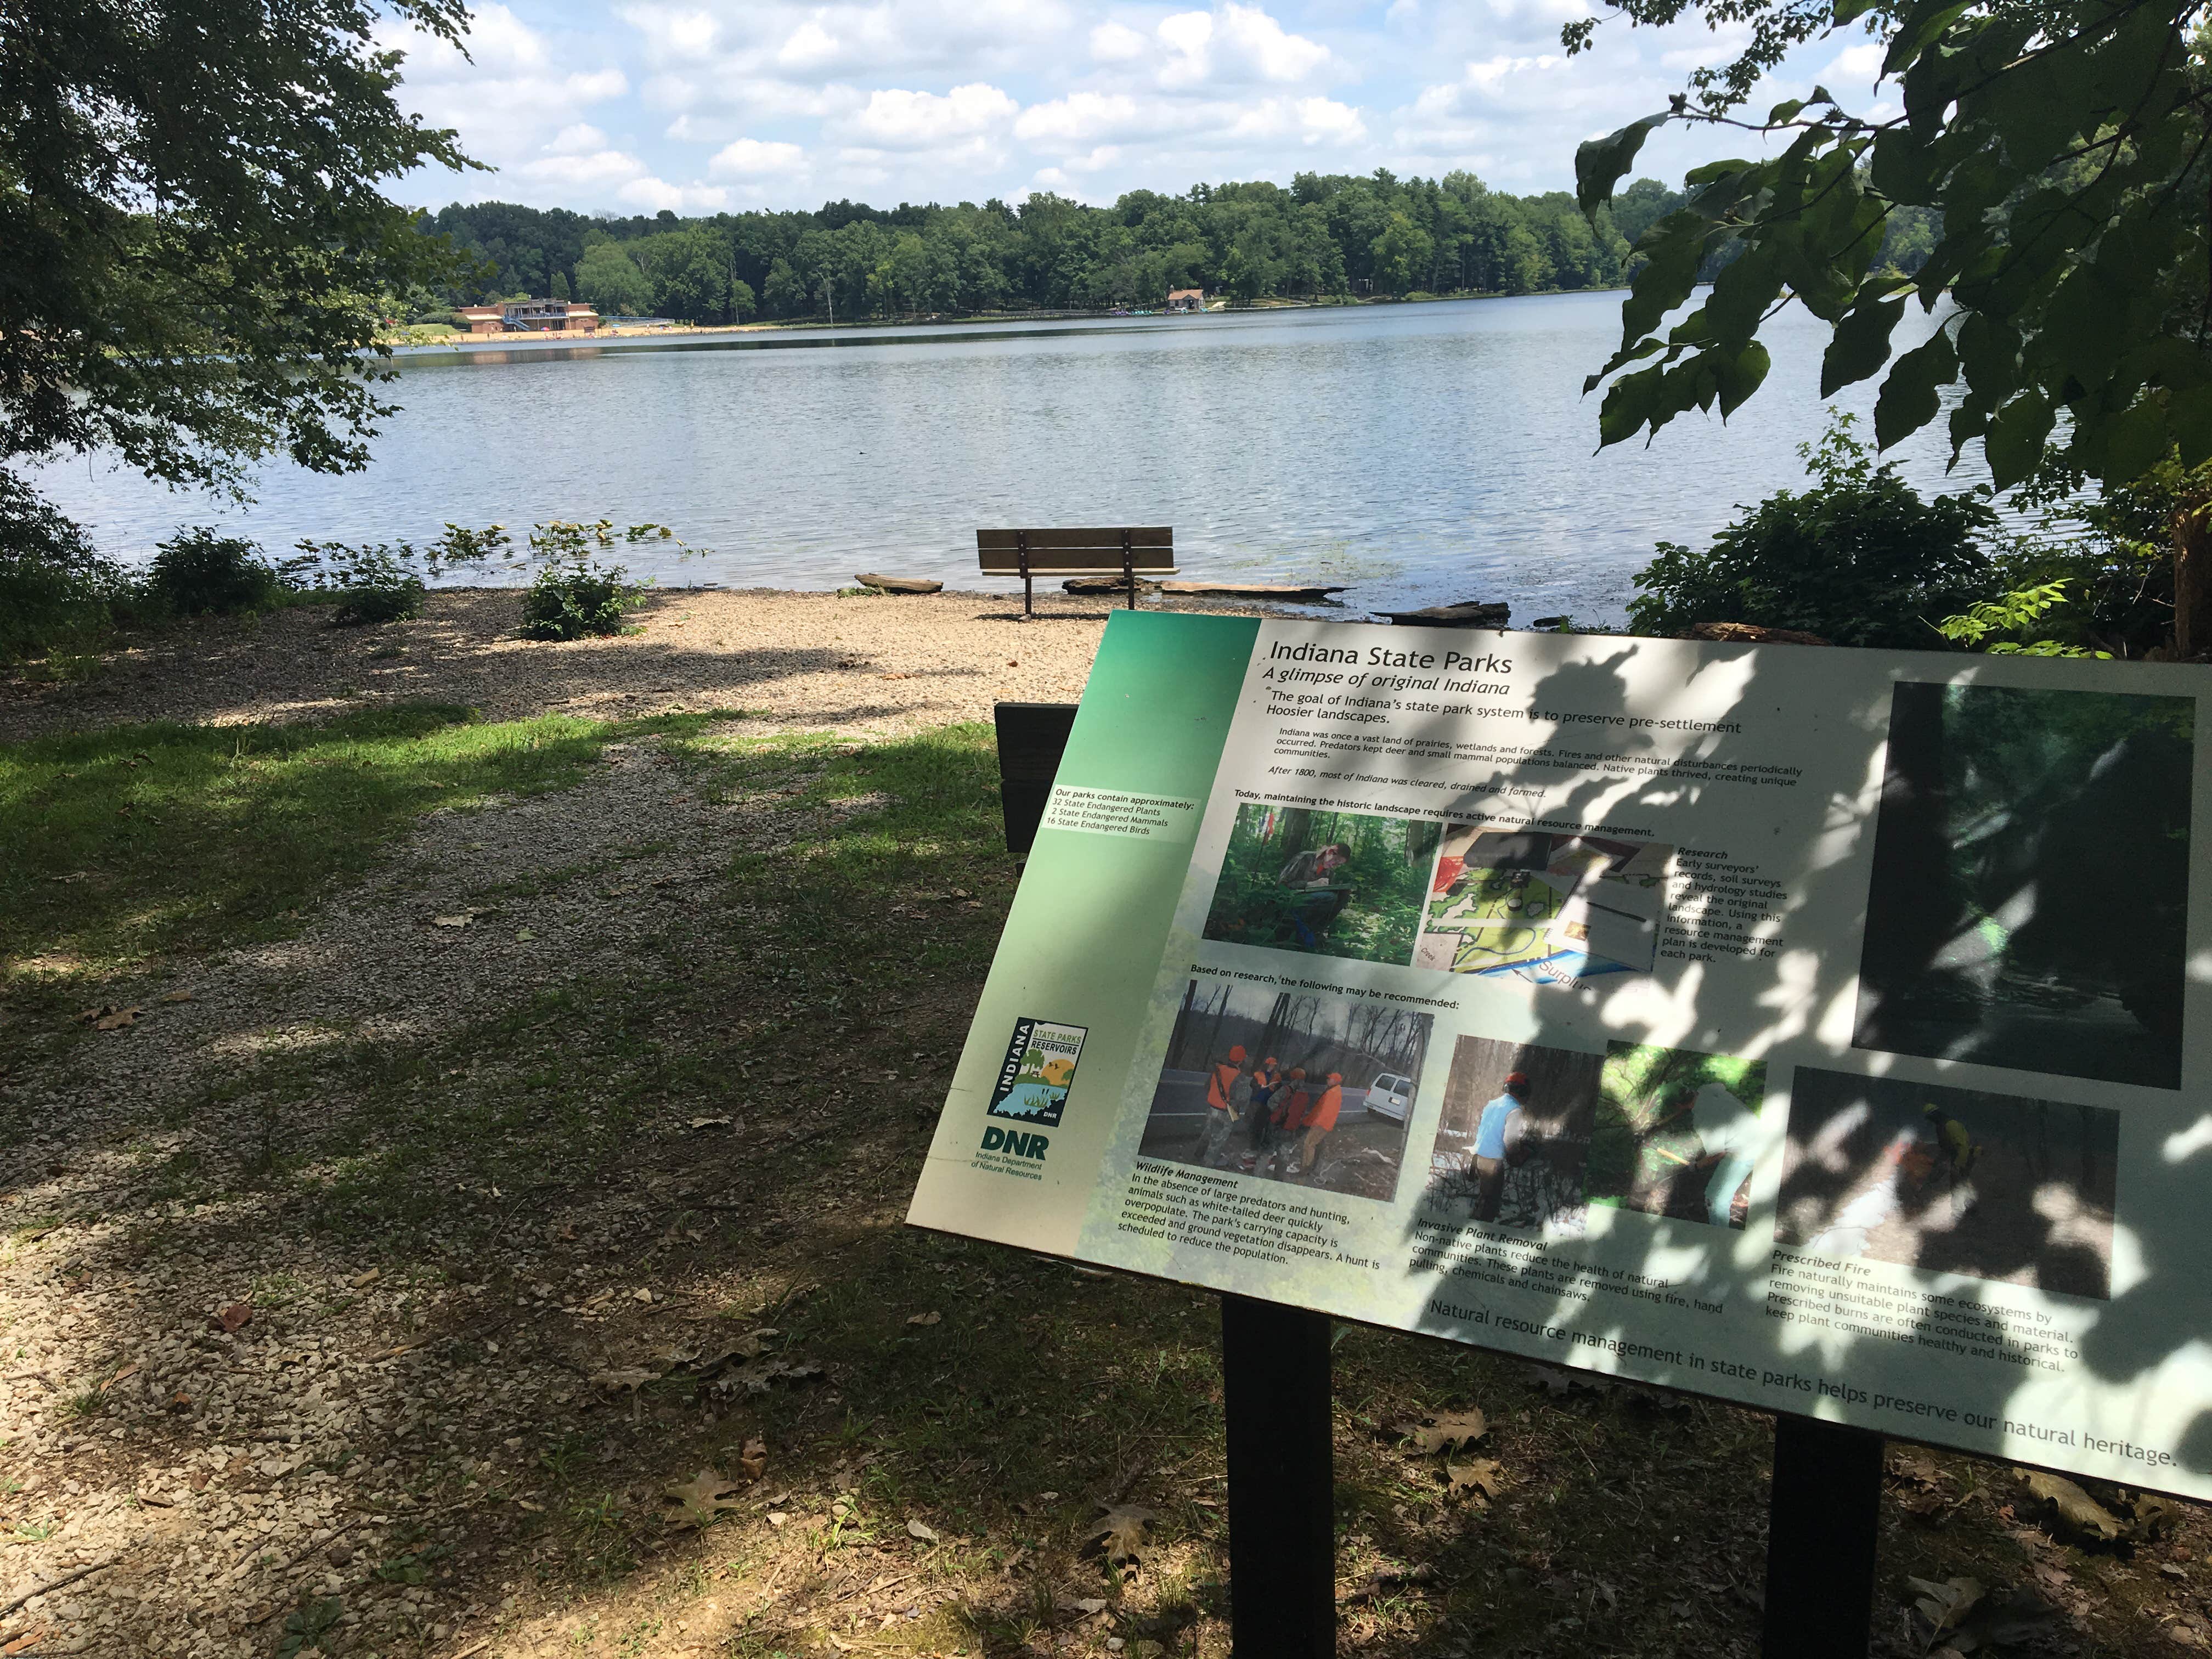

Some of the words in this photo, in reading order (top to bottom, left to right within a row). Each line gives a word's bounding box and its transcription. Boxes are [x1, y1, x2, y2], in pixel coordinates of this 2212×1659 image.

[1270, 641, 1358, 664] Indiana
[1367, 647, 1435, 669] State
[1443, 651, 1513, 674] Parks
[1262, 666, 1274, 679] A
[1277, 667, 1344, 686] glimpse
[1348, 672, 1369, 689] of
[1372, 674, 1440, 691] original
[1443, 678, 1510, 695] Indiana
[1266, 704, 1314, 718] Hoosier
[1317, 708, 1390, 725] landscapes.
[1271, 690, 1294, 702] The
[1297, 693, 1324, 705] goal
[1327, 695, 1342, 705] of
[1344, 696, 1402, 710] Indiana's
[1405, 701, 1440, 713] state
[1442, 704, 1473, 716] park
[1477, 707, 1524, 718] system
[1529, 708, 1539, 720] is
[1544, 710, 1559, 721] to
[1562, 713, 1625, 726] preserve
[1629, 718, 1742, 733] pre-settlement
[1274, 748, 1330, 759] communities.
[1279, 727, 1310, 737] Indiana
[1382, 736, 1402, 744] land
[1415, 740, 1452, 750] prairies,
[1456, 743, 1497, 752] wetlands
[1520, 747, 1554, 757] forests.
[1558, 749, 1582, 759] Fires
[1584, 752, 1603, 760] and
[1605, 754, 1632, 763] other
[1634, 757, 1670, 765] natural
[1673, 759, 1737, 771] disturbances
[1740, 765, 1803, 777] periodically
[1268, 766, 1293, 775] After
[1295, 768, 1317, 778] 1800,
[1343, 772, 1355, 782] of
[1355, 774, 1389, 783] Indiana
[1410, 778, 1447, 790] cleared,
[1450, 782, 1487, 792] drained
[1508, 787, 1545, 798] farmed.
[1064, 799, 1085, 808] State
[1087, 802, 1135, 813] Endangered
[1135, 806, 1160, 816] Plants
[1097, 794, 1128, 803] contain
[1130, 798, 1194, 811] approximately:
[1234, 789, 1261, 800] Today,
[1264, 793, 1317, 806] maintaining
[1319, 798, 1335, 806] the
[1336, 799, 1372, 810] historic
[1374, 803, 1421, 815] landscape
[1423, 809, 1464, 819] requires
[1466, 813, 1496, 821] active
[1498, 816, 1535, 826] natural
[1537, 820, 1582, 830] resource
[1584, 824, 1655, 837] management.
[1058, 818, 1079, 827] State
[1080, 820, 1128, 832] Endangered
[1129, 826, 1150, 835] Birds
[1059, 808, 1080, 817] State
[1082, 811, 1130, 822] Endangered
[1130, 816, 1168, 827] Mammals
[1677, 858, 1703, 870] Early
[1678, 847, 1728, 860] Research
[1674, 871, 1716, 883] records,
[1720, 874, 1738, 883] soil
[1742, 878, 1781, 889] surveys
[1662, 937, 1685, 947] plan
[1689, 940, 1697, 949] is
[1700, 941, 1757, 956] developed
[1760, 947, 1776, 958] for
[1664, 927, 1710, 938] resource
[1713, 932, 1784, 947] management
[1660, 950, 1686, 959] each
[1688, 953, 1716, 963] park.
[1190, 964, 1218, 975] Based
[1233, 972, 1278, 985] research,
[1280, 977, 1297, 986] the
[1299, 979, 1344, 995] following
[1345, 988, 1367, 998] may
[1368, 989, 1381, 998] be
[1384, 992, 1459, 1009] recommended:
[1031, 1040, 1077, 1055] RESERVOIRS
[1033, 1030, 1056, 1041] STATE
[1057, 1032, 1081, 1044] PARKS
[1000, 1024, 1030, 1092] INDIANA
[981, 1126, 1049, 1160] DNR
[975, 1151, 1000, 1163] Indiana
[1002, 1156, 1042, 1170] Department
[979, 1162, 1004, 1173] Natural
[1005, 1167, 1042, 1181] Resources
[1136, 1161, 1174, 1177] Wildlife
[1175, 1169, 1239, 1189] Management
[1132, 1173, 1141, 1183] In
[1143, 1176, 1159, 1186] the
[1161, 1179, 1199, 1194] absence
[1201, 1187, 1212, 1196] of
[1214, 1188, 1238, 1202] large
[1239, 1195, 1286, 1211] predators
[1289, 1205, 1308, 1215] and
[1310, 1207, 1350, 1225] hunting,
[1118, 1222, 1165, 1239] scheduled
[1167, 1232, 1177, 1241] to
[1179, 1235, 1212, 1249] reduce
[1215, 1241, 1231, 1252] the
[1233, 1246, 1288, 1265] population.
[1417, 1217, 1463, 1234] Invasive
[1465, 1227, 1496, 1241] Plant
[1498, 1233, 1548, 1251] Removal
[1772, 1250, 1841, 1271] Prescribed
[1844, 1263, 1871, 1276] Fire
[1409, 1259, 1448, 1276] pulling,
[1452, 1266, 1505, 1284] chemicals
[1508, 1278, 1529, 1289] and
[1531, 1281, 1590, 1302] chainsaws.
[1771, 1263, 1794, 1277] Fire
[1799, 1271, 1853, 1289] naturally
[1857, 1282, 1917, 1299] maintains
[1922, 1293, 1955, 1306] some
[1958, 1300, 2031, 1319] ecosystems
[2036, 1312, 2052, 1325] by
[1427, 1299, 1490, 1325] Natural
[1494, 1316, 1566, 1340] resource
[1571, 1331, 1683, 1365] management
[1689, 1352, 1705, 1370] in
[1710, 1360, 1757, 1380] state
[1762, 1371, 1812, 1392] parks
[1818, 1378, 1869, 1404] helps
[1873, 1394, 1959, 1422] preserve
[1962, 1412, 1997, 1430] our
[2004, 1421, 2075, 1446] natural
[2084, 1432, 2177, 1466] heritage.
